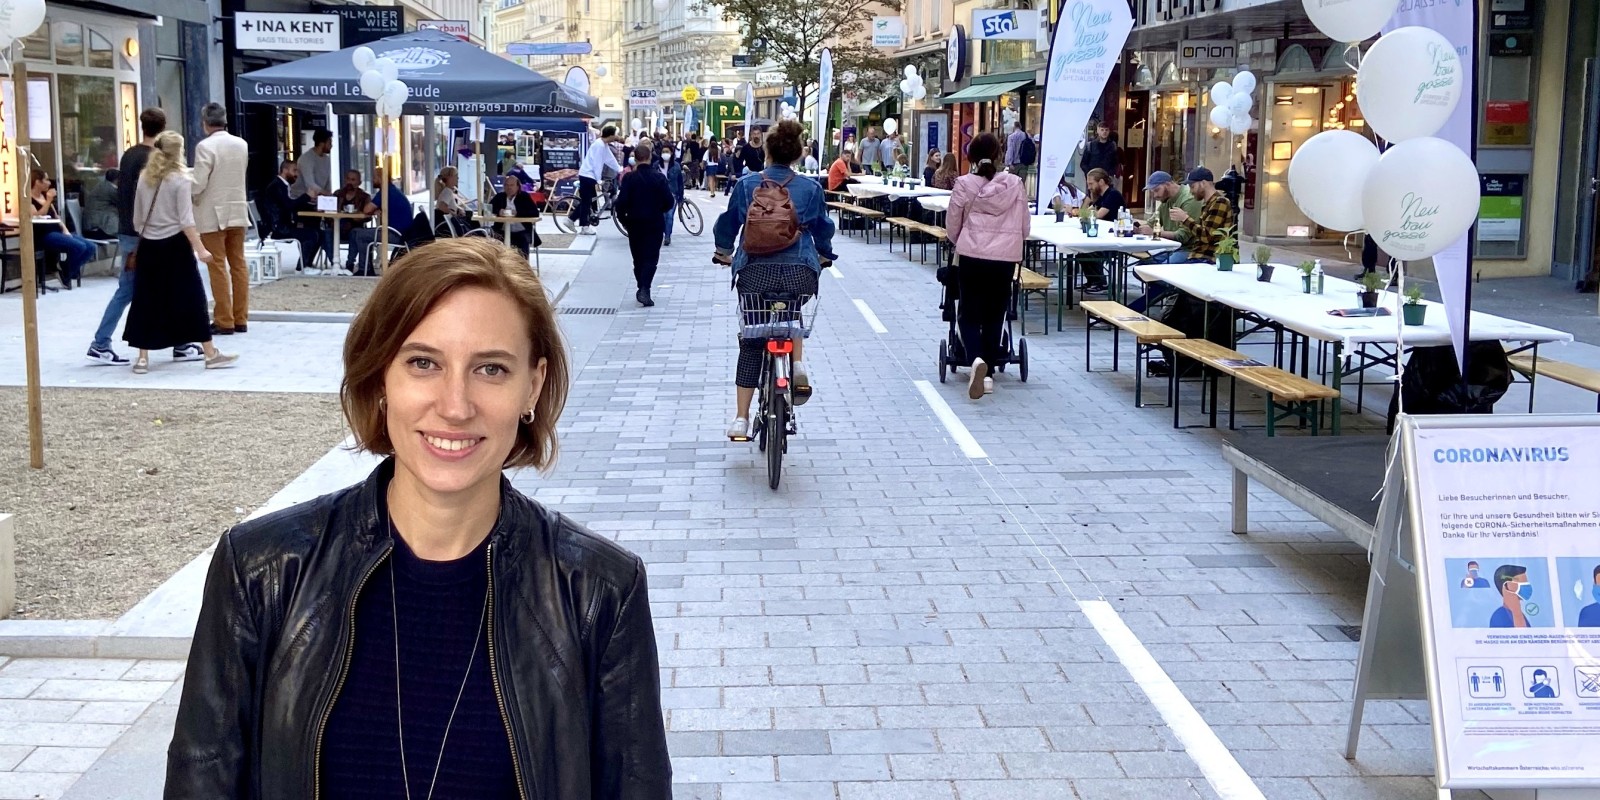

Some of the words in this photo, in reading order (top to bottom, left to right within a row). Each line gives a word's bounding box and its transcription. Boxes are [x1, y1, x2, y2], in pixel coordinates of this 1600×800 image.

[322, 10, 398, 19] HLMAIER
[1072, 1, 1112, 33] Neu
[257, 20, 286, 32] INA
[291, 21, 334, 33] KENT
[366, 19, 398, 27] WIEN
[419, 23, 466, 33] Orbank
[985, 15, 1013, 33] sta
[257, 36, 276, 44] BAGS
[277, 36, 293, 44] TELL
[295, 37, 324, 45] STORIES
[1074, 25, 1109, 47] bau
[1183, 43, 1234, 58] orion
[1427, 42, 1456, 65] Neu
[1055, 45, 1107, 82] gasse
[1433, 64, 1454, 76] bau
[1065, 67, 1092, 75] STRASSE
[254, 82, 305, 96] Genuss
[311, 82, 338, 96] und
[344, 83, 441, 98] Leeude
[631, 90, 657, 98] PETER
[1413, 76, 1454, 104] gasse
[1400, 191, 1440, 219] Neu
[1400, 215, 1434, 231] bau
[1382, 230, 1429, 243] gasse
[1433, 446, 1570, 464] CORONAVIRUS
[1438, 494, 1458, 502] Liebe
[1441, 522, 1473, 530] folgende
[1474, 521, 1597, 529] CORONA-Sicherheitsmaßnahmen
[1442, 531, 1466, 539] Danke
[1492, 530, 1539, 538] Verständnis!
